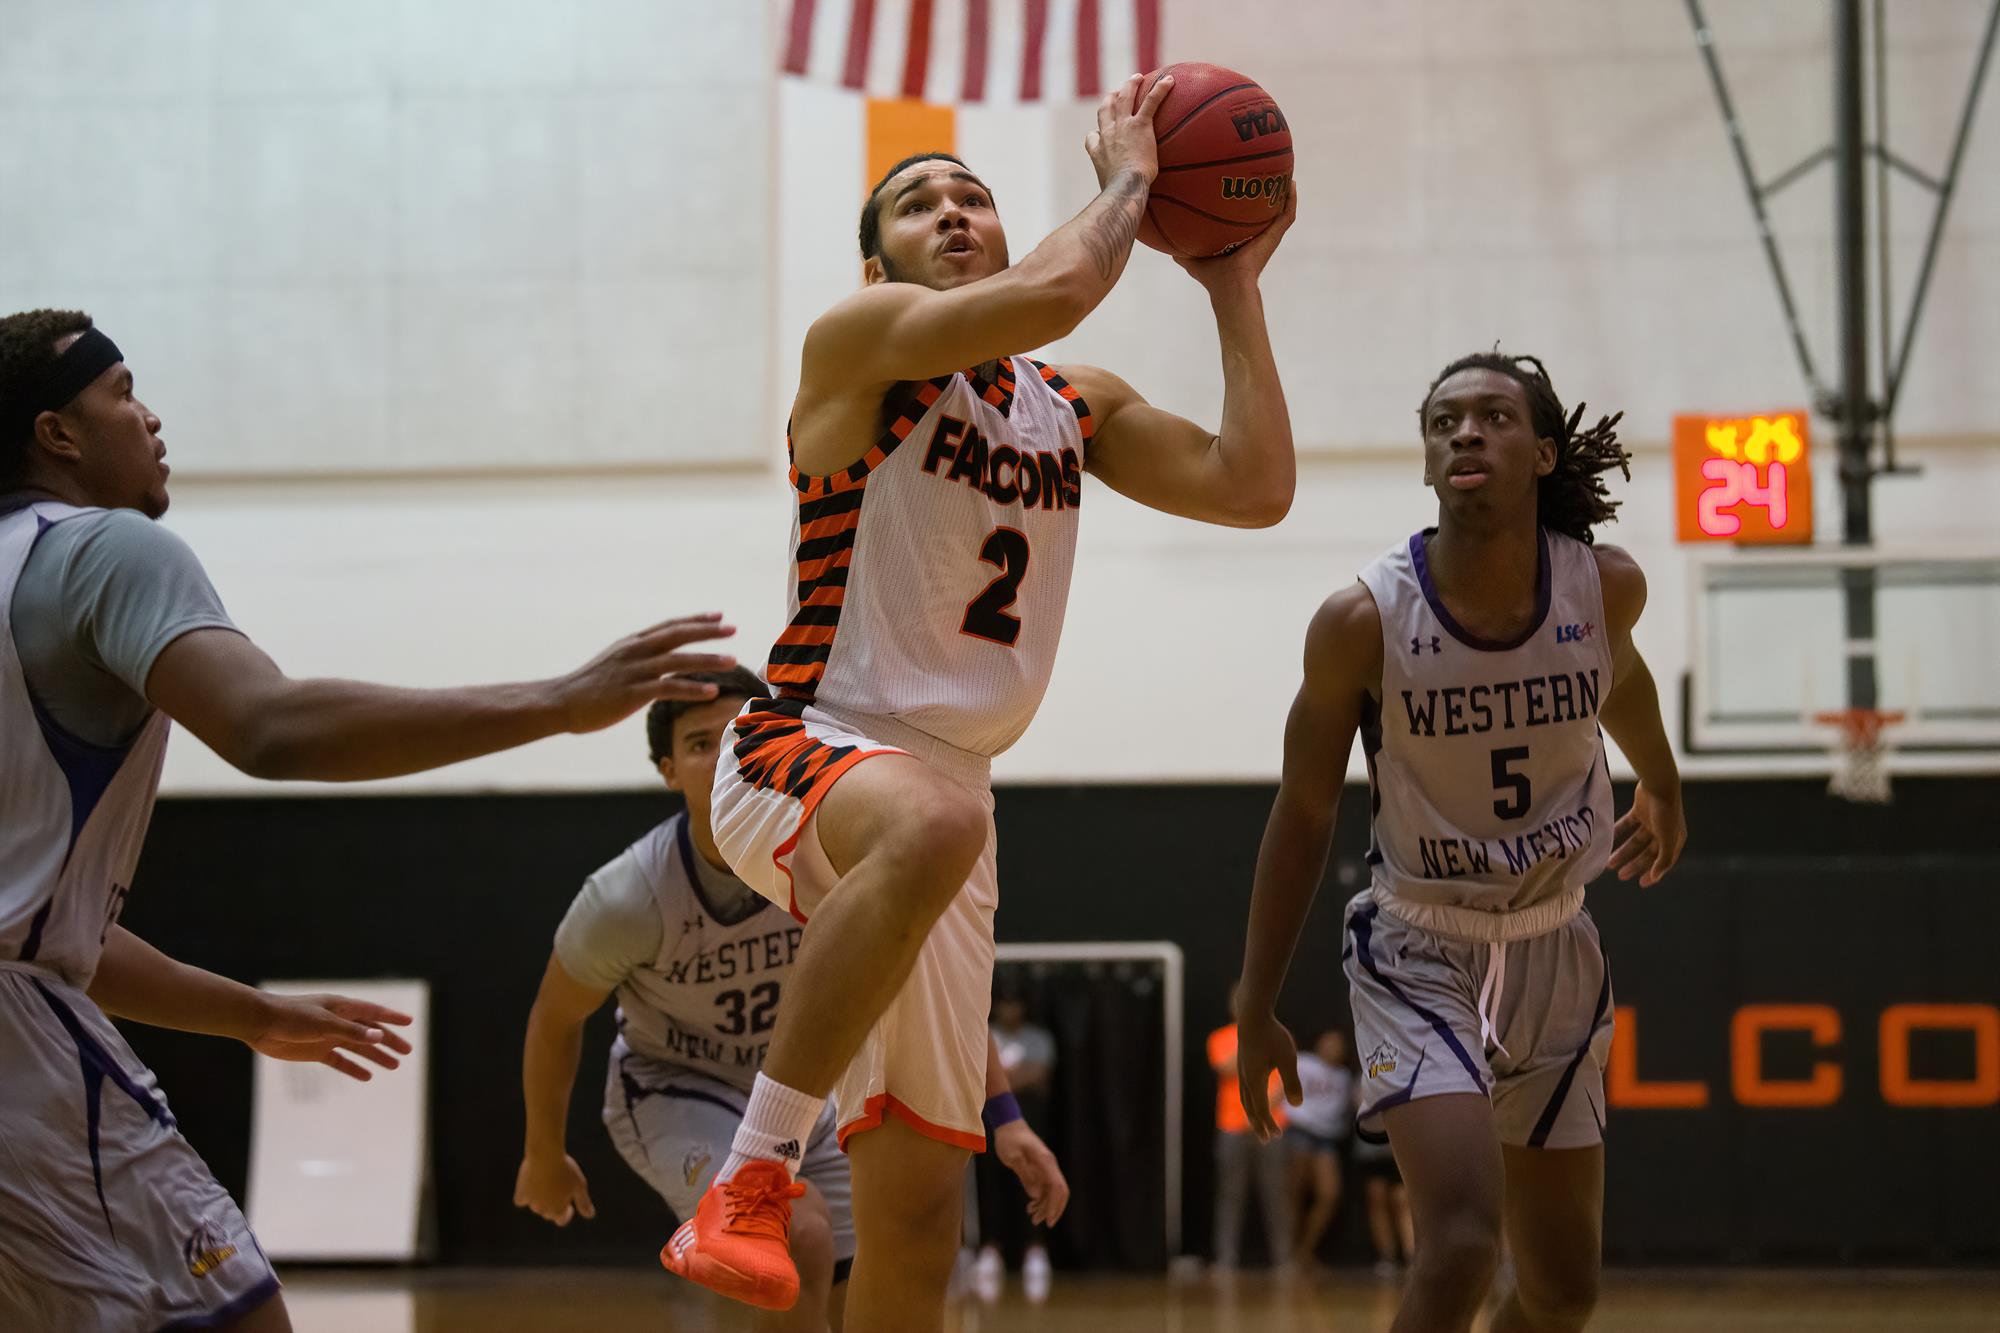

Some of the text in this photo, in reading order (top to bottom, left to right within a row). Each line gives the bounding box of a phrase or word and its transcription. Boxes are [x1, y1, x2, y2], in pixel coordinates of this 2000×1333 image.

[1230, 106, 1288, 142] CAA
[1221, 174, 1292, 208] lson
[1698, 457, 1788, 536] 24
[959, 525, 1031, 649] 2
[1401, 668, 1600, 737] WESTERN
[1490, 745, 1532, 822] 5
[1418, 836, 1494, 880] NEW
[714, 980, 781, 1036] 32
